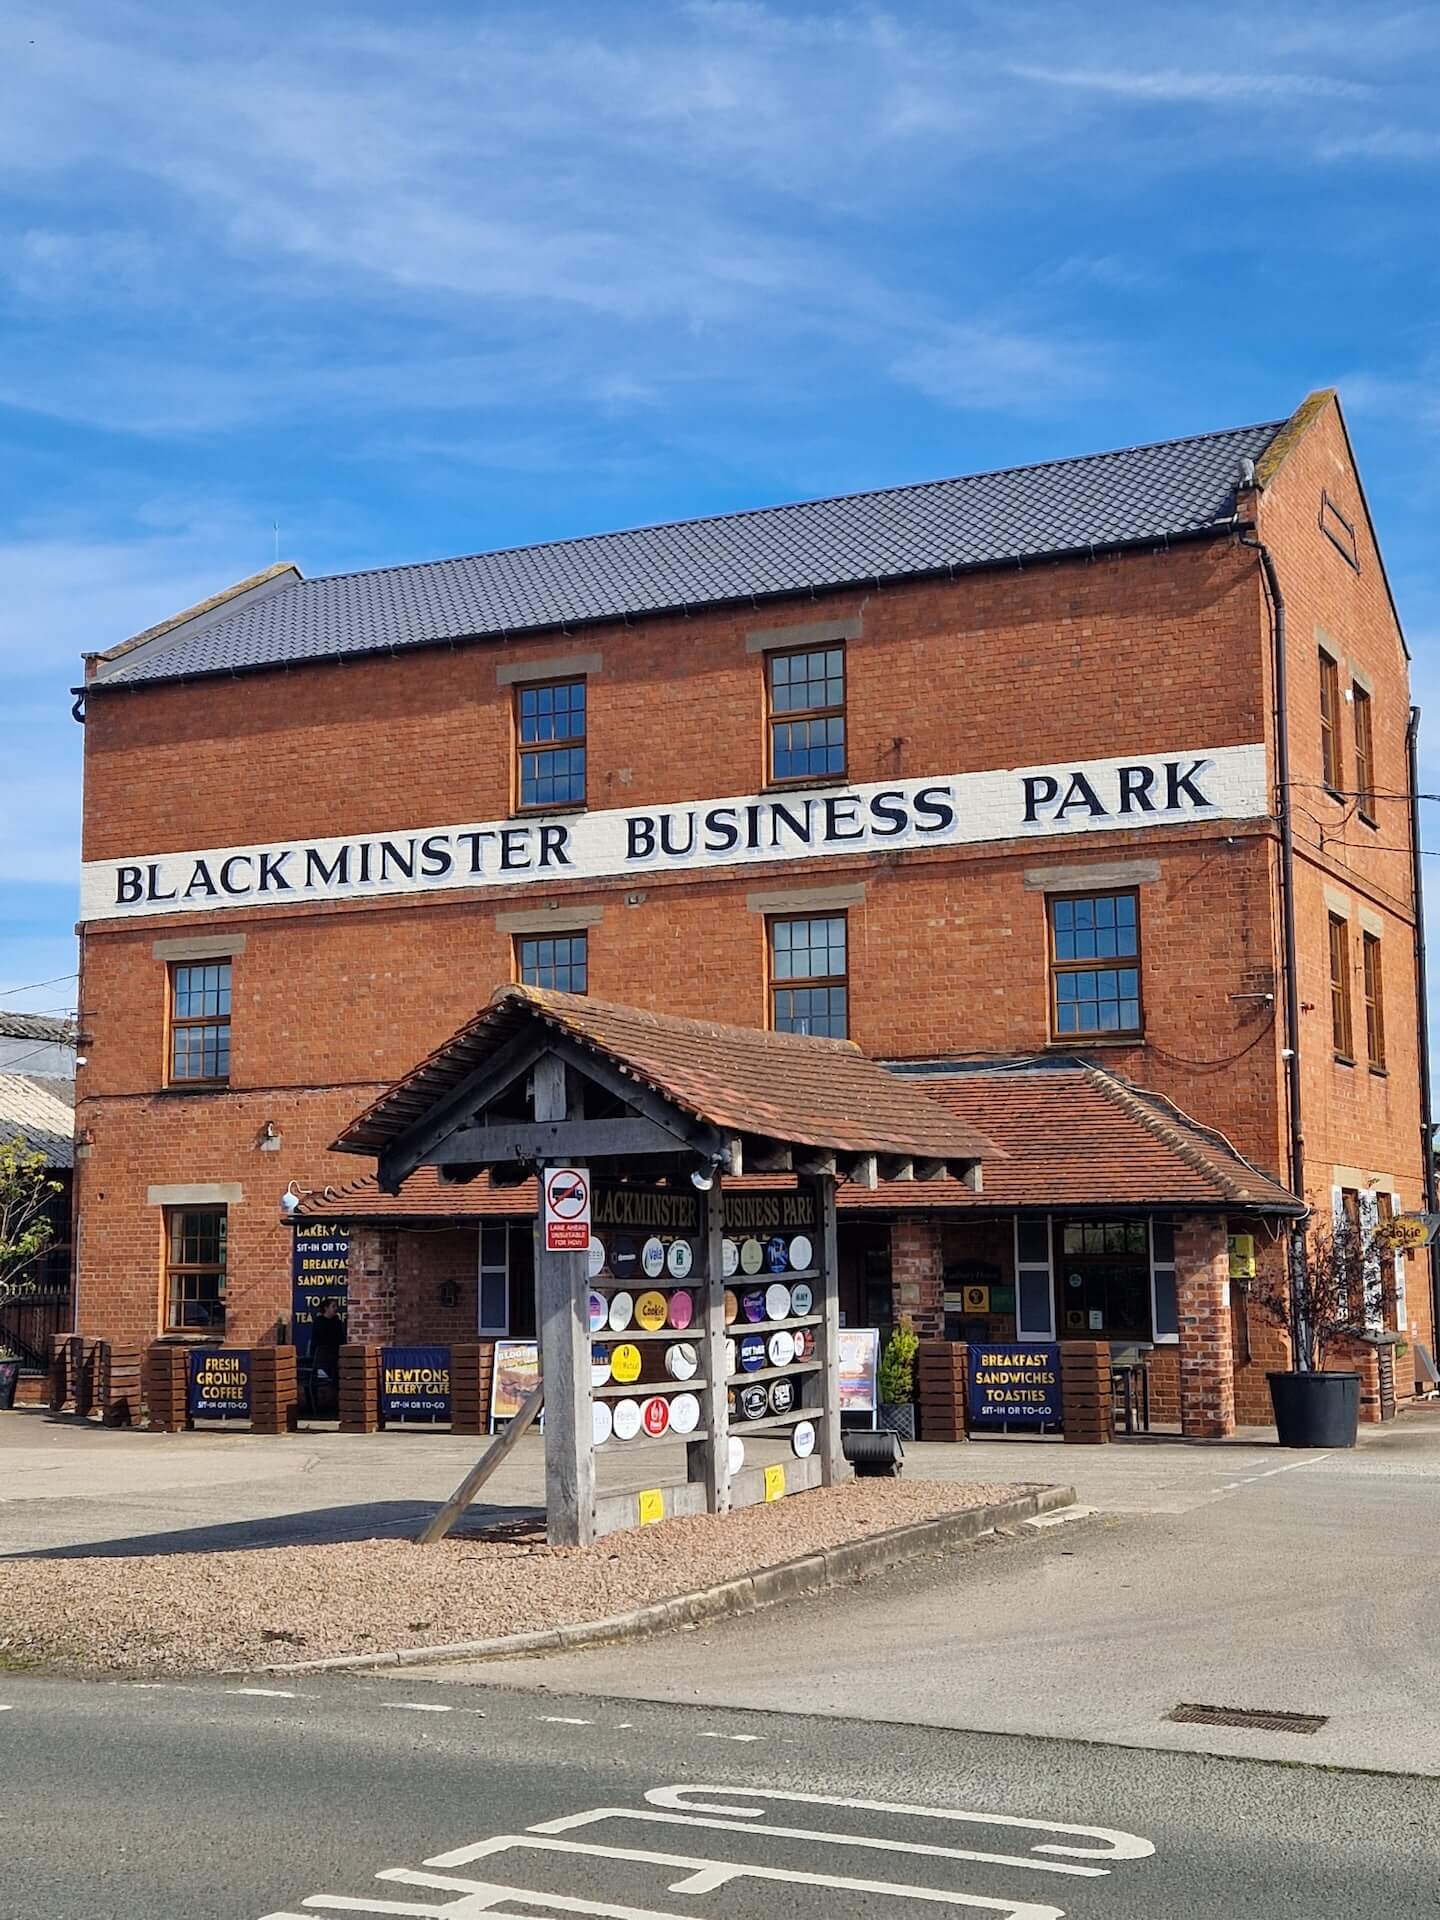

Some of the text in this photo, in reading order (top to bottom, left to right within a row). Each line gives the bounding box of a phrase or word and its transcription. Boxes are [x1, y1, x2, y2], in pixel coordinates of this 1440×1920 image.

[115, 758, 1214, 904] BLACKMINSTER BUSINESS PARK
[591, 1190, 697, 1228] LACKMINSTER
[783, 1196, 816, 1227] PARK
[321, 1243, 335, 1252] OR
[205, 1358, 240, 1371] FRESH
[981, 1354, 1049, 1367] BREAKFAST
[196, 1372, 248, 1385] GROUND
[385, 1369, 450, 1382] NEWTONS
[975, 1371, 1056, 1385] SANDWICHES
[202, 1386, 244, 1399] COFFEE
[986, 1389, 1046, 1402] TOASTIES
[981, 1406, 1053, 1415] SIT-IN OR TO-GO
